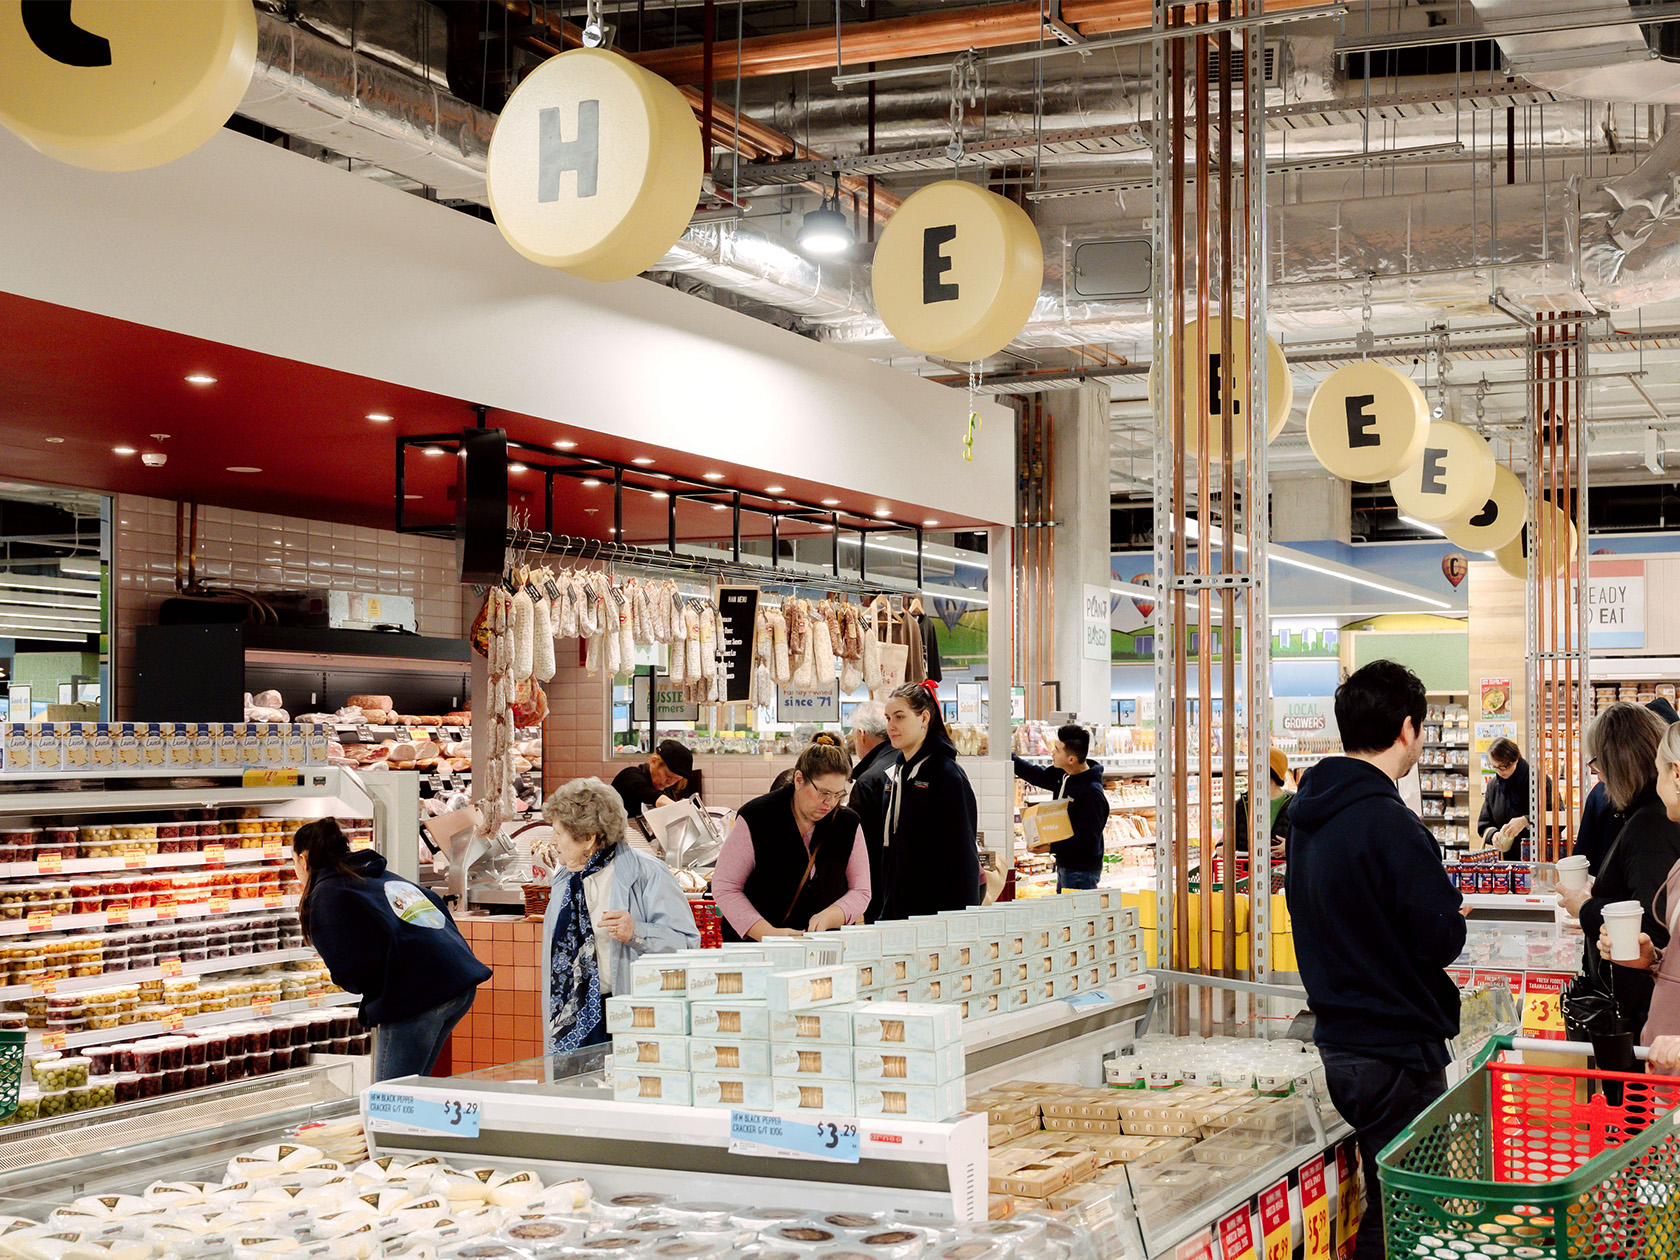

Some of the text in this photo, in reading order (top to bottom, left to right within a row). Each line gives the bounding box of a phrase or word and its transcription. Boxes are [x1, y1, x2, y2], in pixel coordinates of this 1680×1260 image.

[538, 99, 600, 203] H
[923, 224, 959, 305] E
[1210, 353, 1240, 416] E
[1345, 394, 1381, 449] E
[1420, 448, 1448, 495] E
[1450, 557, 1459, 577] C
[1087, 595, 1107, 619] PLANT
[1600, 607, 1625, 624] EAT
[647, 691, 684, 703] USSIE
[784, 696, 813, 707] since
[647, 704, 684, 713] Frmers
[1288, 703, 1320, 716] LOCAL
[1284, 717, 1325, 729] GROWERS
[1530, 999, 1560, 1022] $3.4
[370, 1103, 392, 1113] CRACKER
[381, 1094, 396, 1102] BLACK
[397, 1095, 414, 1104] PEPPER
[444, 1099, 478, 1126] $3.29
[744, 1114, 761, 1124] BLACK
[762, 1115, 782, 1125] PEPPER
[732, 1123, 757, 1134] CRACKER
[817, 1121, 857, 1149] $3.29
[1308, 1209, 1327, 1255] $5.99
